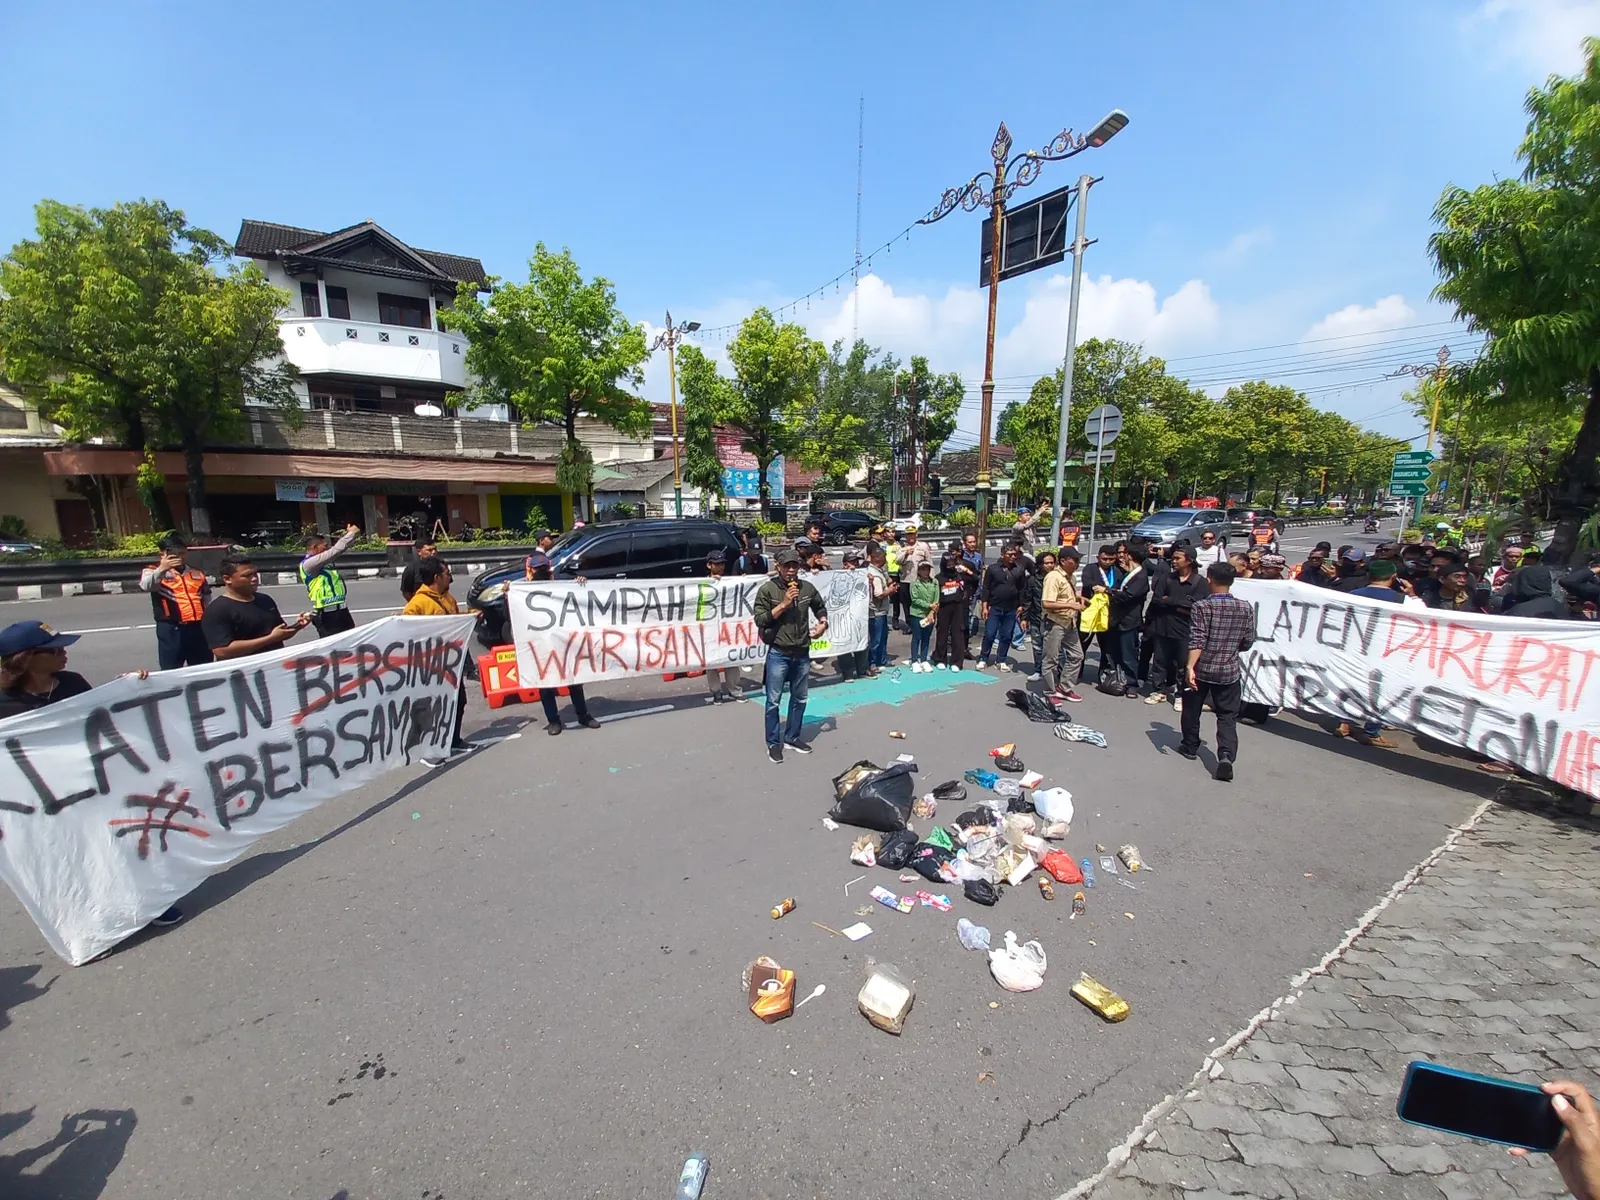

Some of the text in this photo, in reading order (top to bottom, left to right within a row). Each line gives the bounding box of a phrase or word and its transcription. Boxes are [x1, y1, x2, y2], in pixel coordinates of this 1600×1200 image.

[525, 584, 686, 631] SAMPAH
[528, 624, 706, 681] WARISAN
[728, 645, 766, 662] CUCU
[1382, 613, 1600, 711] DARURAT
[0, 637, 463, 815] LATEN BERSINAR
